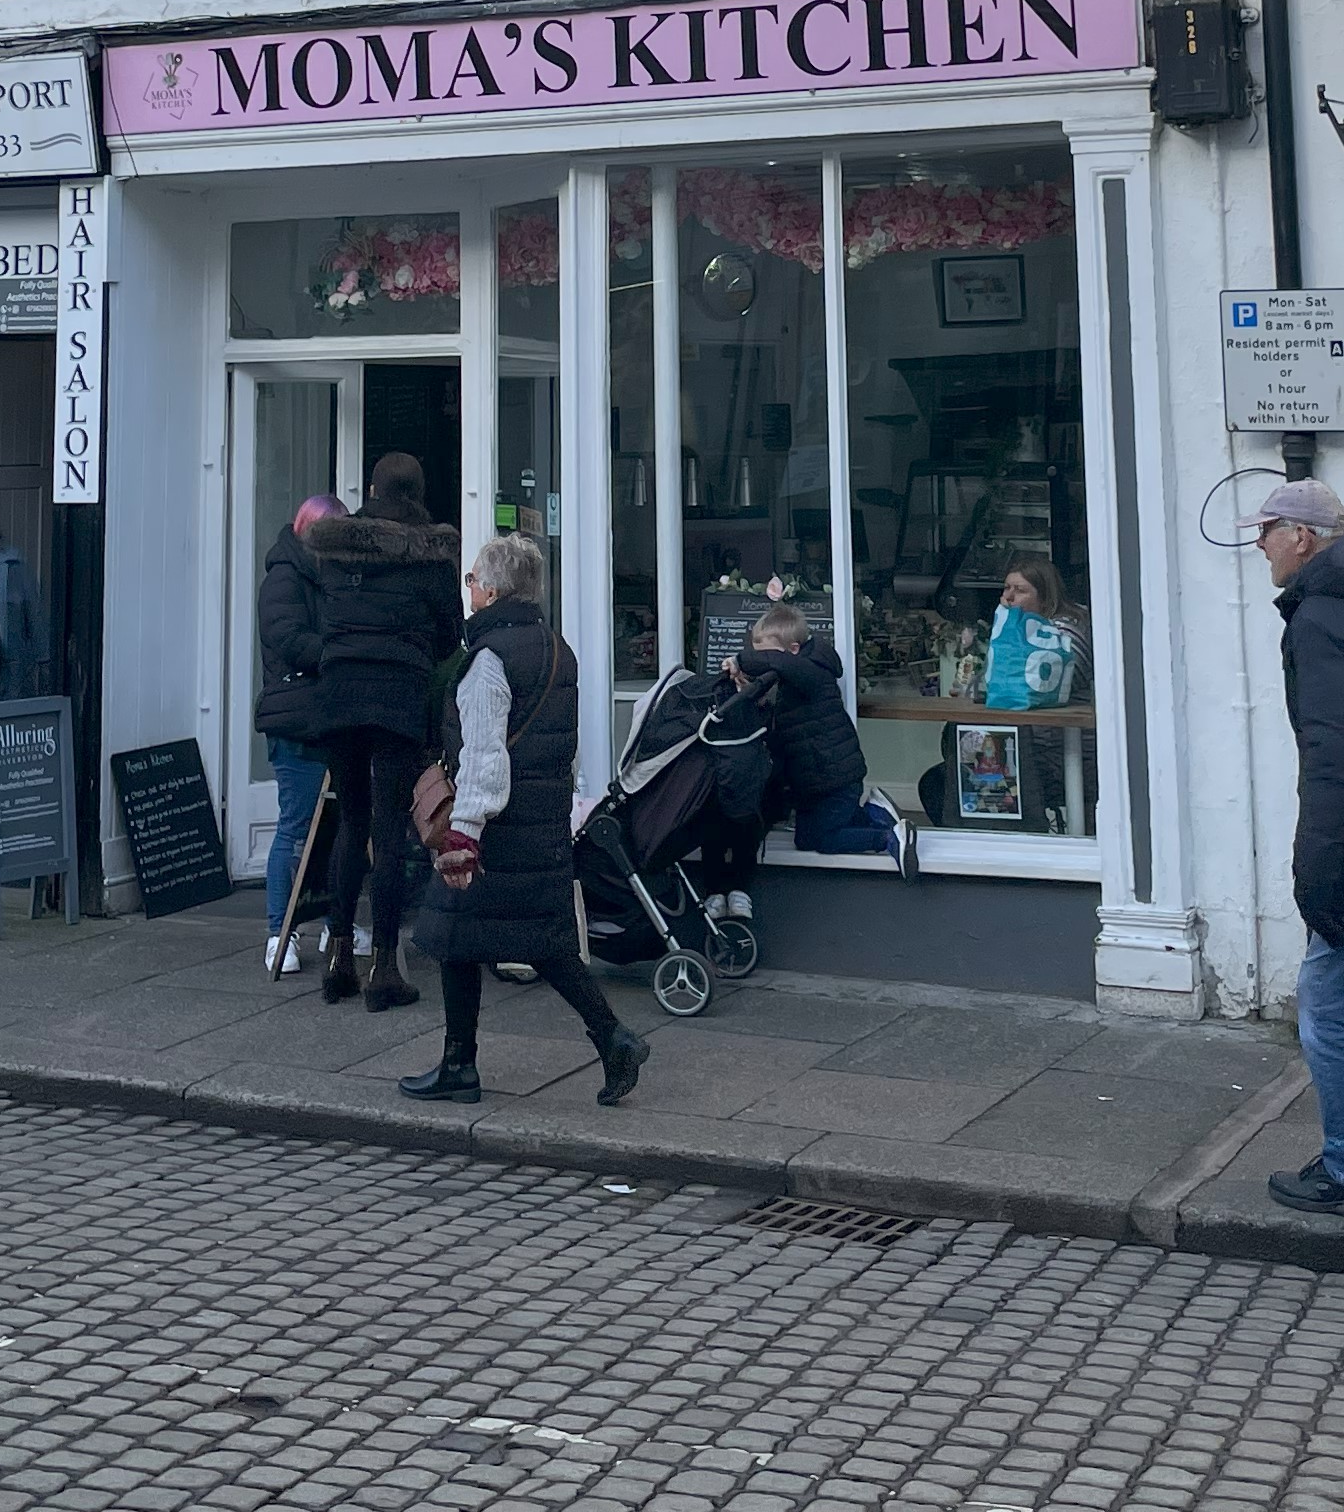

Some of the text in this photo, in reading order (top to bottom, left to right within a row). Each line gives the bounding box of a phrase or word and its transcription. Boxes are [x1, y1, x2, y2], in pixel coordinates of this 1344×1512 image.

[209, 18, 578, 116] MOMA'S
[151, 100, 192, 109] KITCHEN
[1268, 298, 1295, 307] Mon
[1305, 297, 1327, 307] Sat
[1238, 305, 1254, 325] P
[62, 187, 95, 490] HAIR SALON
[1227, 338, 1325, 350] Resident permit
[1253, 351, 1299, 361] holders
[1280, 369, 1292, 377] or
[1278, 384, 1306, 393] hour
[1257, 401, 1319, 410] No return
[1248, 414, 1285, 424] within
[1302, 414, 1330, 424] hour
